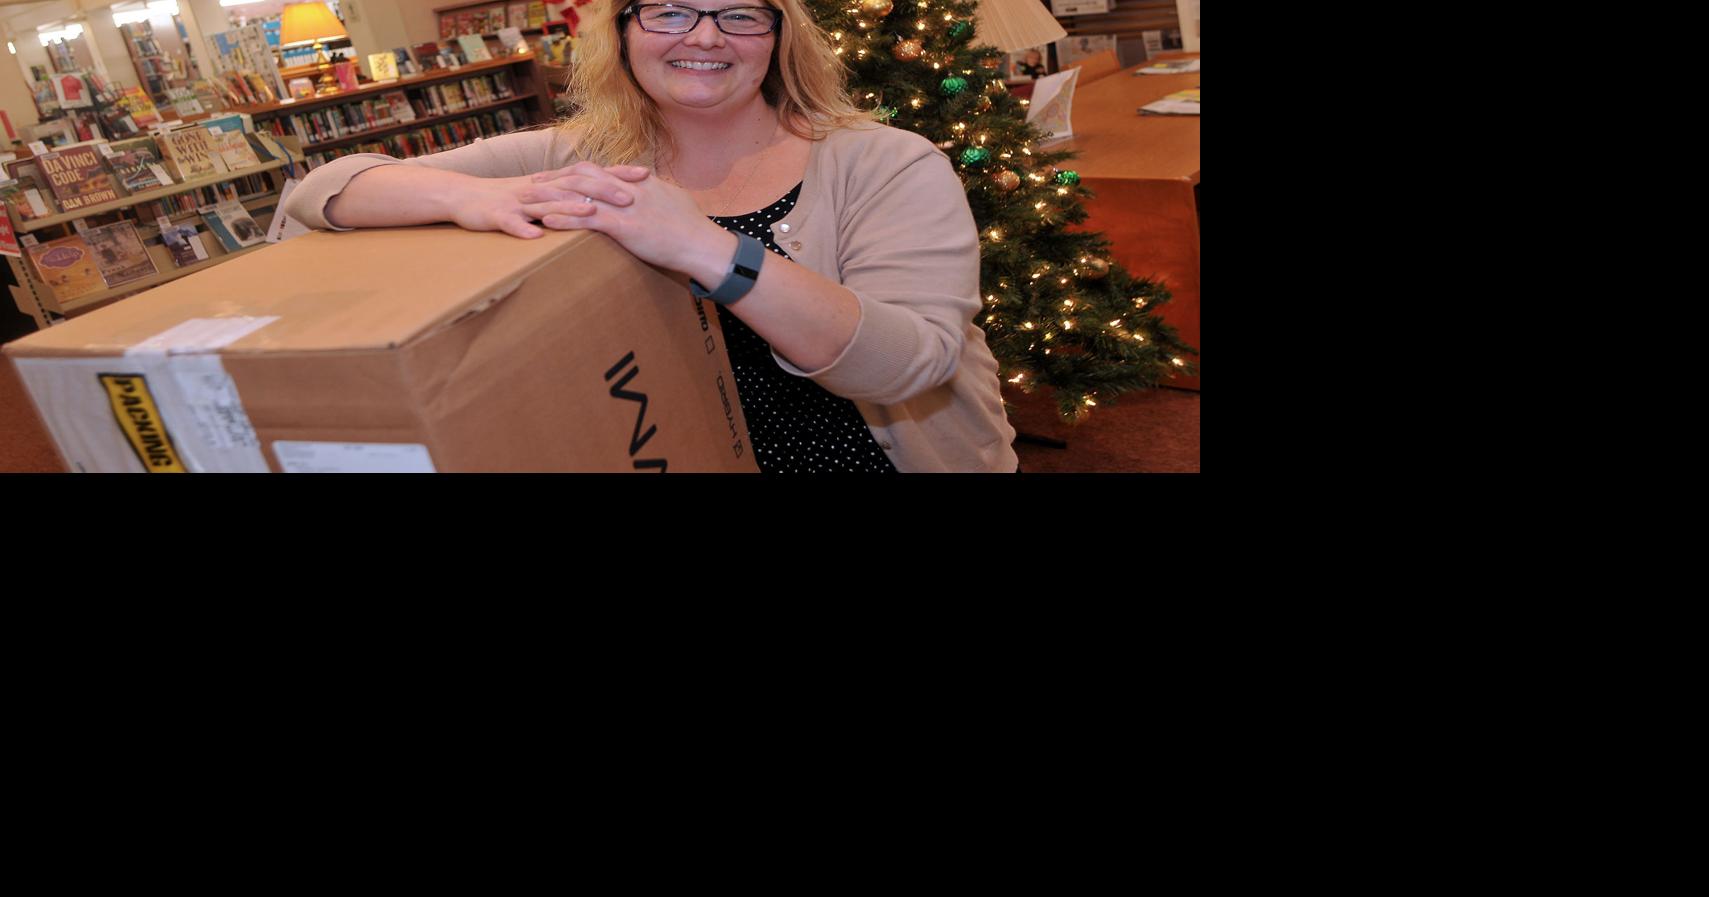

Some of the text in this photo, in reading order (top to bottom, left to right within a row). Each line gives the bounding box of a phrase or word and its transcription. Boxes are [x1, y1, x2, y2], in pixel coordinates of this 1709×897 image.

[43, 151, 98, 175] DA VINCI
[51, 168, 85, 187] CODE
[62, 189, 117, 210] DAN BROWN
[694, 297, 709, 332] QUIC
[716, 375, 738, 439] HYBRID
[113, 377, 173, 468] PACKING
